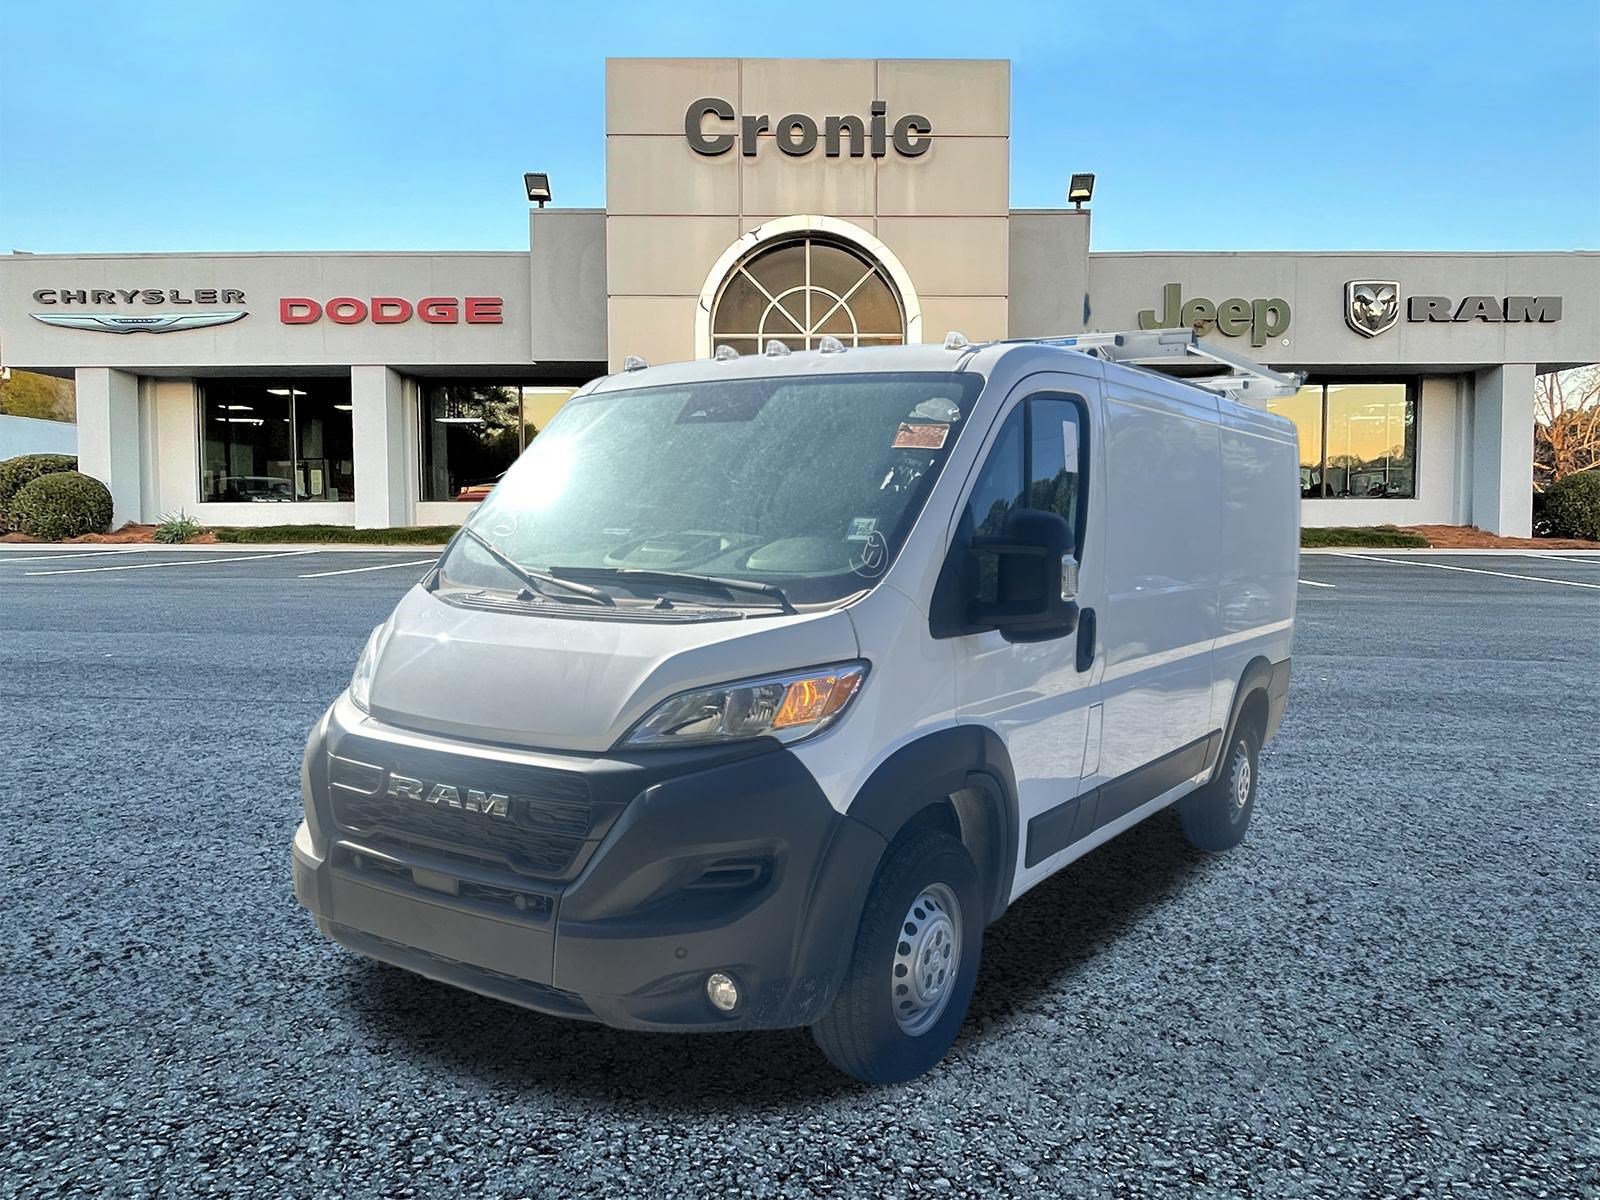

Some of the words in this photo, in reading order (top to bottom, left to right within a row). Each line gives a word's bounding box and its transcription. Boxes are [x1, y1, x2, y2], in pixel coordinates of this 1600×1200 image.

[684, 97, 932, 158] Cronic
[32, 289, 246, 304] CHRYSLER
[279, 297, 503, 324] DODGE
[1407, 296, 1563, 322] RAM
[1138, 283, 1291, 347] Jeep
[387, 772, 509, 817] RAM
